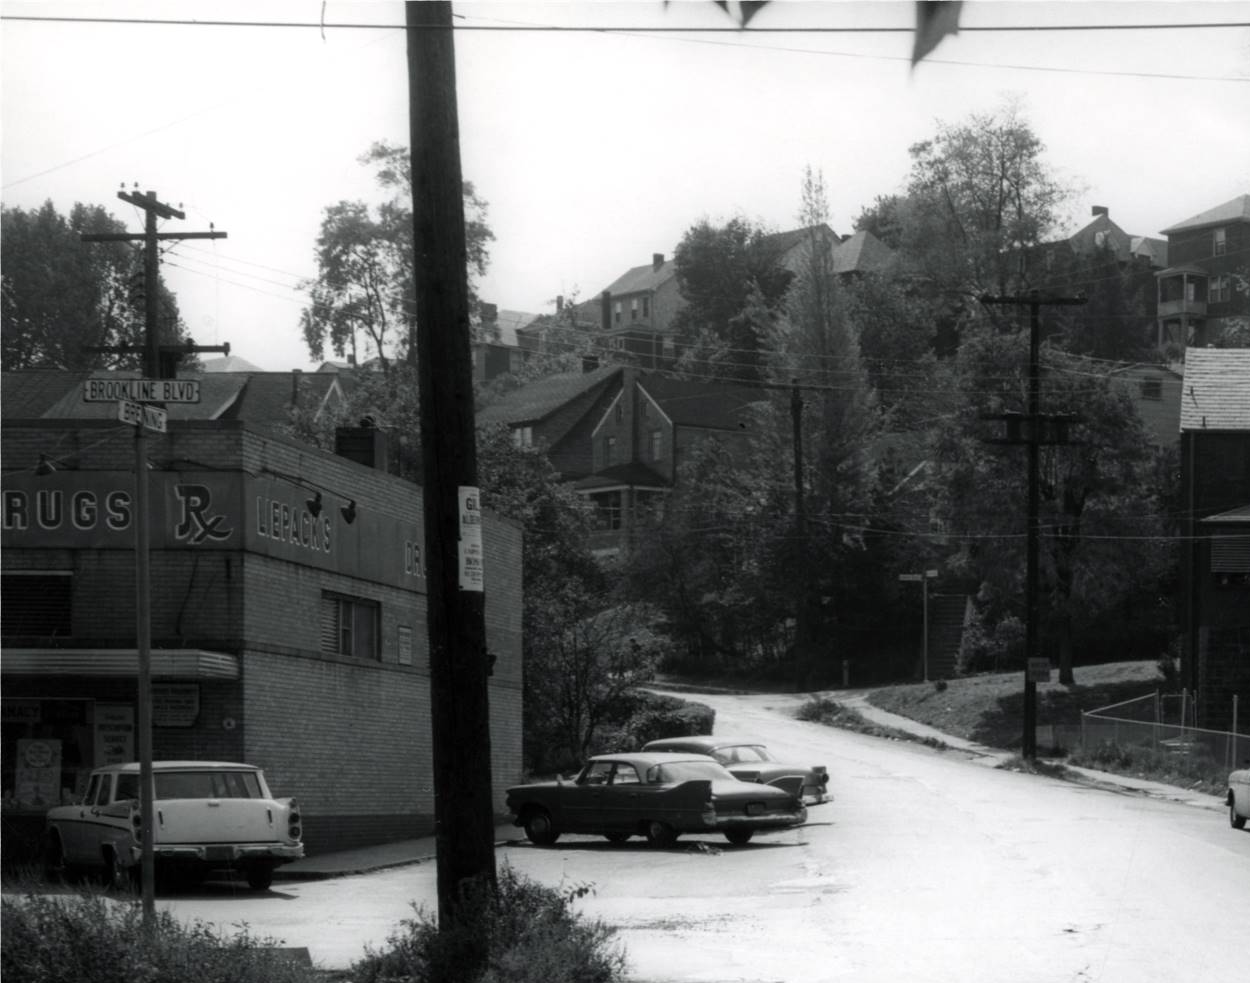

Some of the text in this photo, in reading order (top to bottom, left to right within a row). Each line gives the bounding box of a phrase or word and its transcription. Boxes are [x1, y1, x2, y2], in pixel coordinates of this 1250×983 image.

[91, 382, 194, 401] BROOKLINE BLVD
[124, 402, 163, 429] BRENING
[2, 490, 132, 530] RUGS
